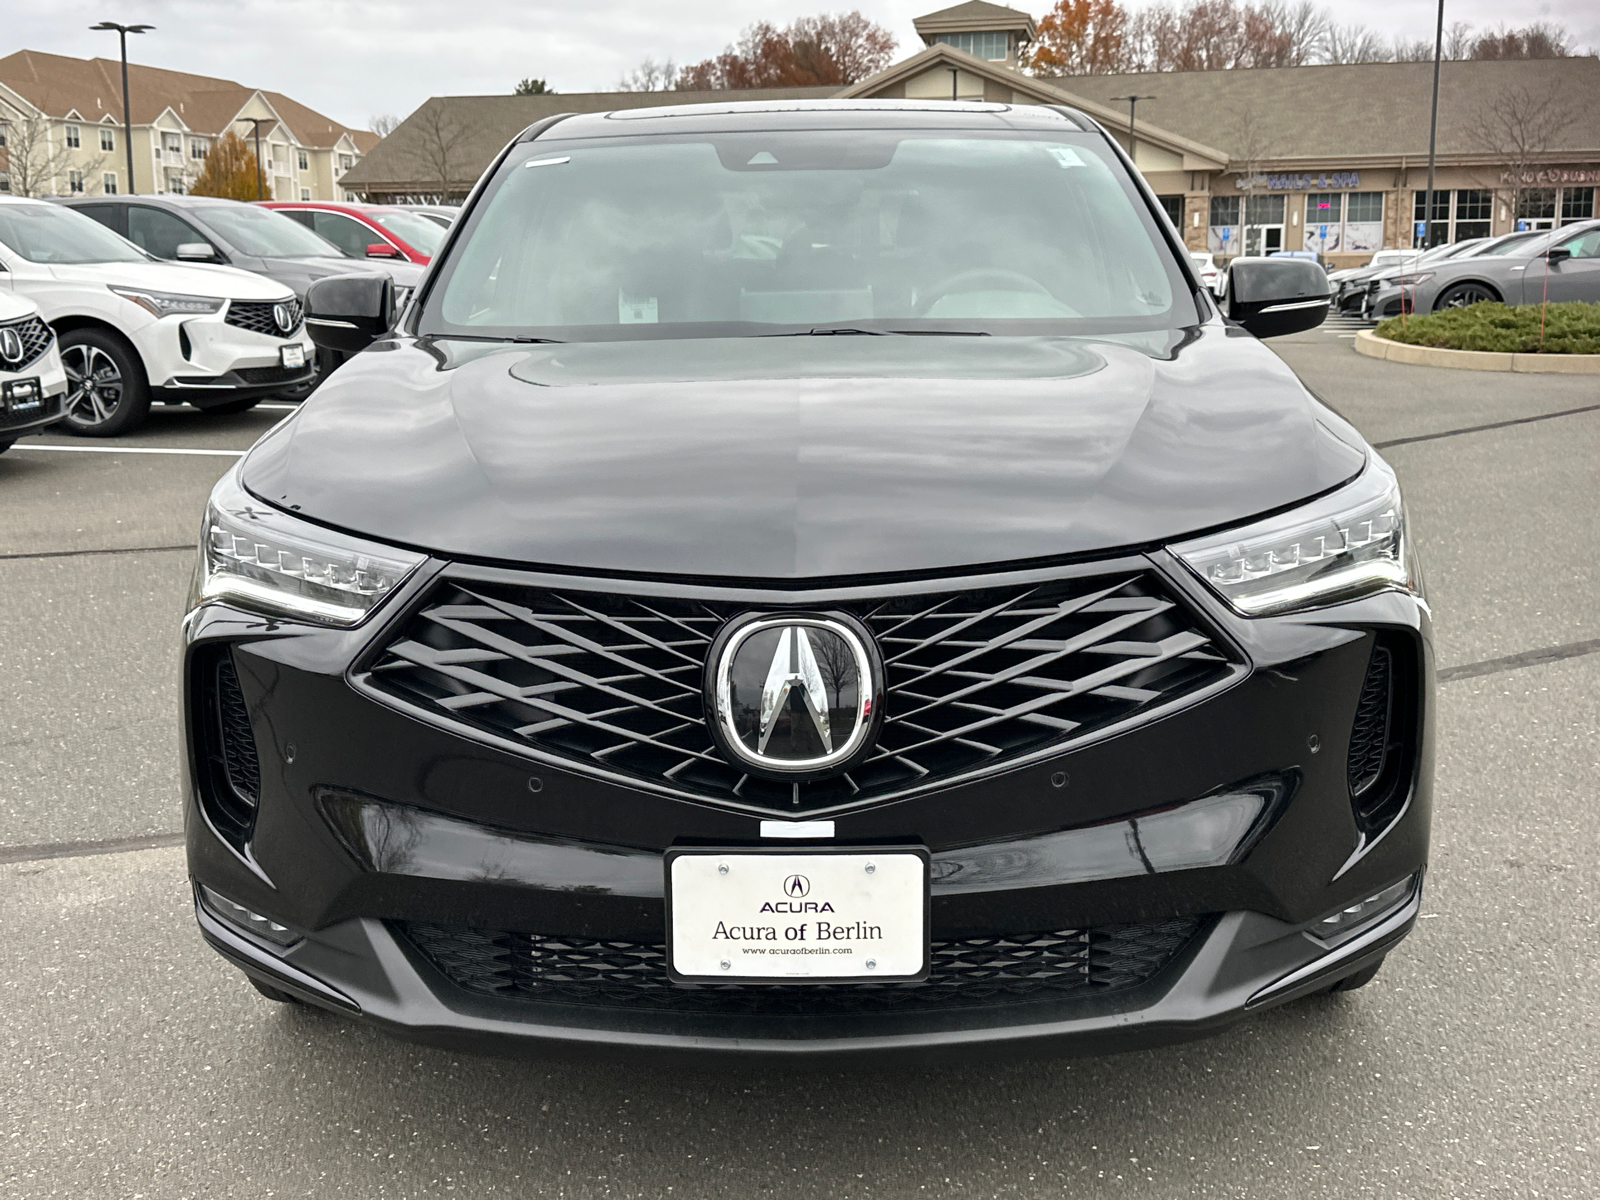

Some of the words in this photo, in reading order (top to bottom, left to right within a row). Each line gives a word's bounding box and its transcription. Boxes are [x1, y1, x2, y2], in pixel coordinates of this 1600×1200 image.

[1267, 173, 1311, 190] NAILS
[1331, 172, 1359, 188] SPA
[759, 902, 835, 914] ACURA
[712, 920, 777, 941] Acura
[784, 923, 807, 941] of
[816, 920, 883, 941] Berlin
[742, 947, 853, 956] www.acuraofberlin.com
